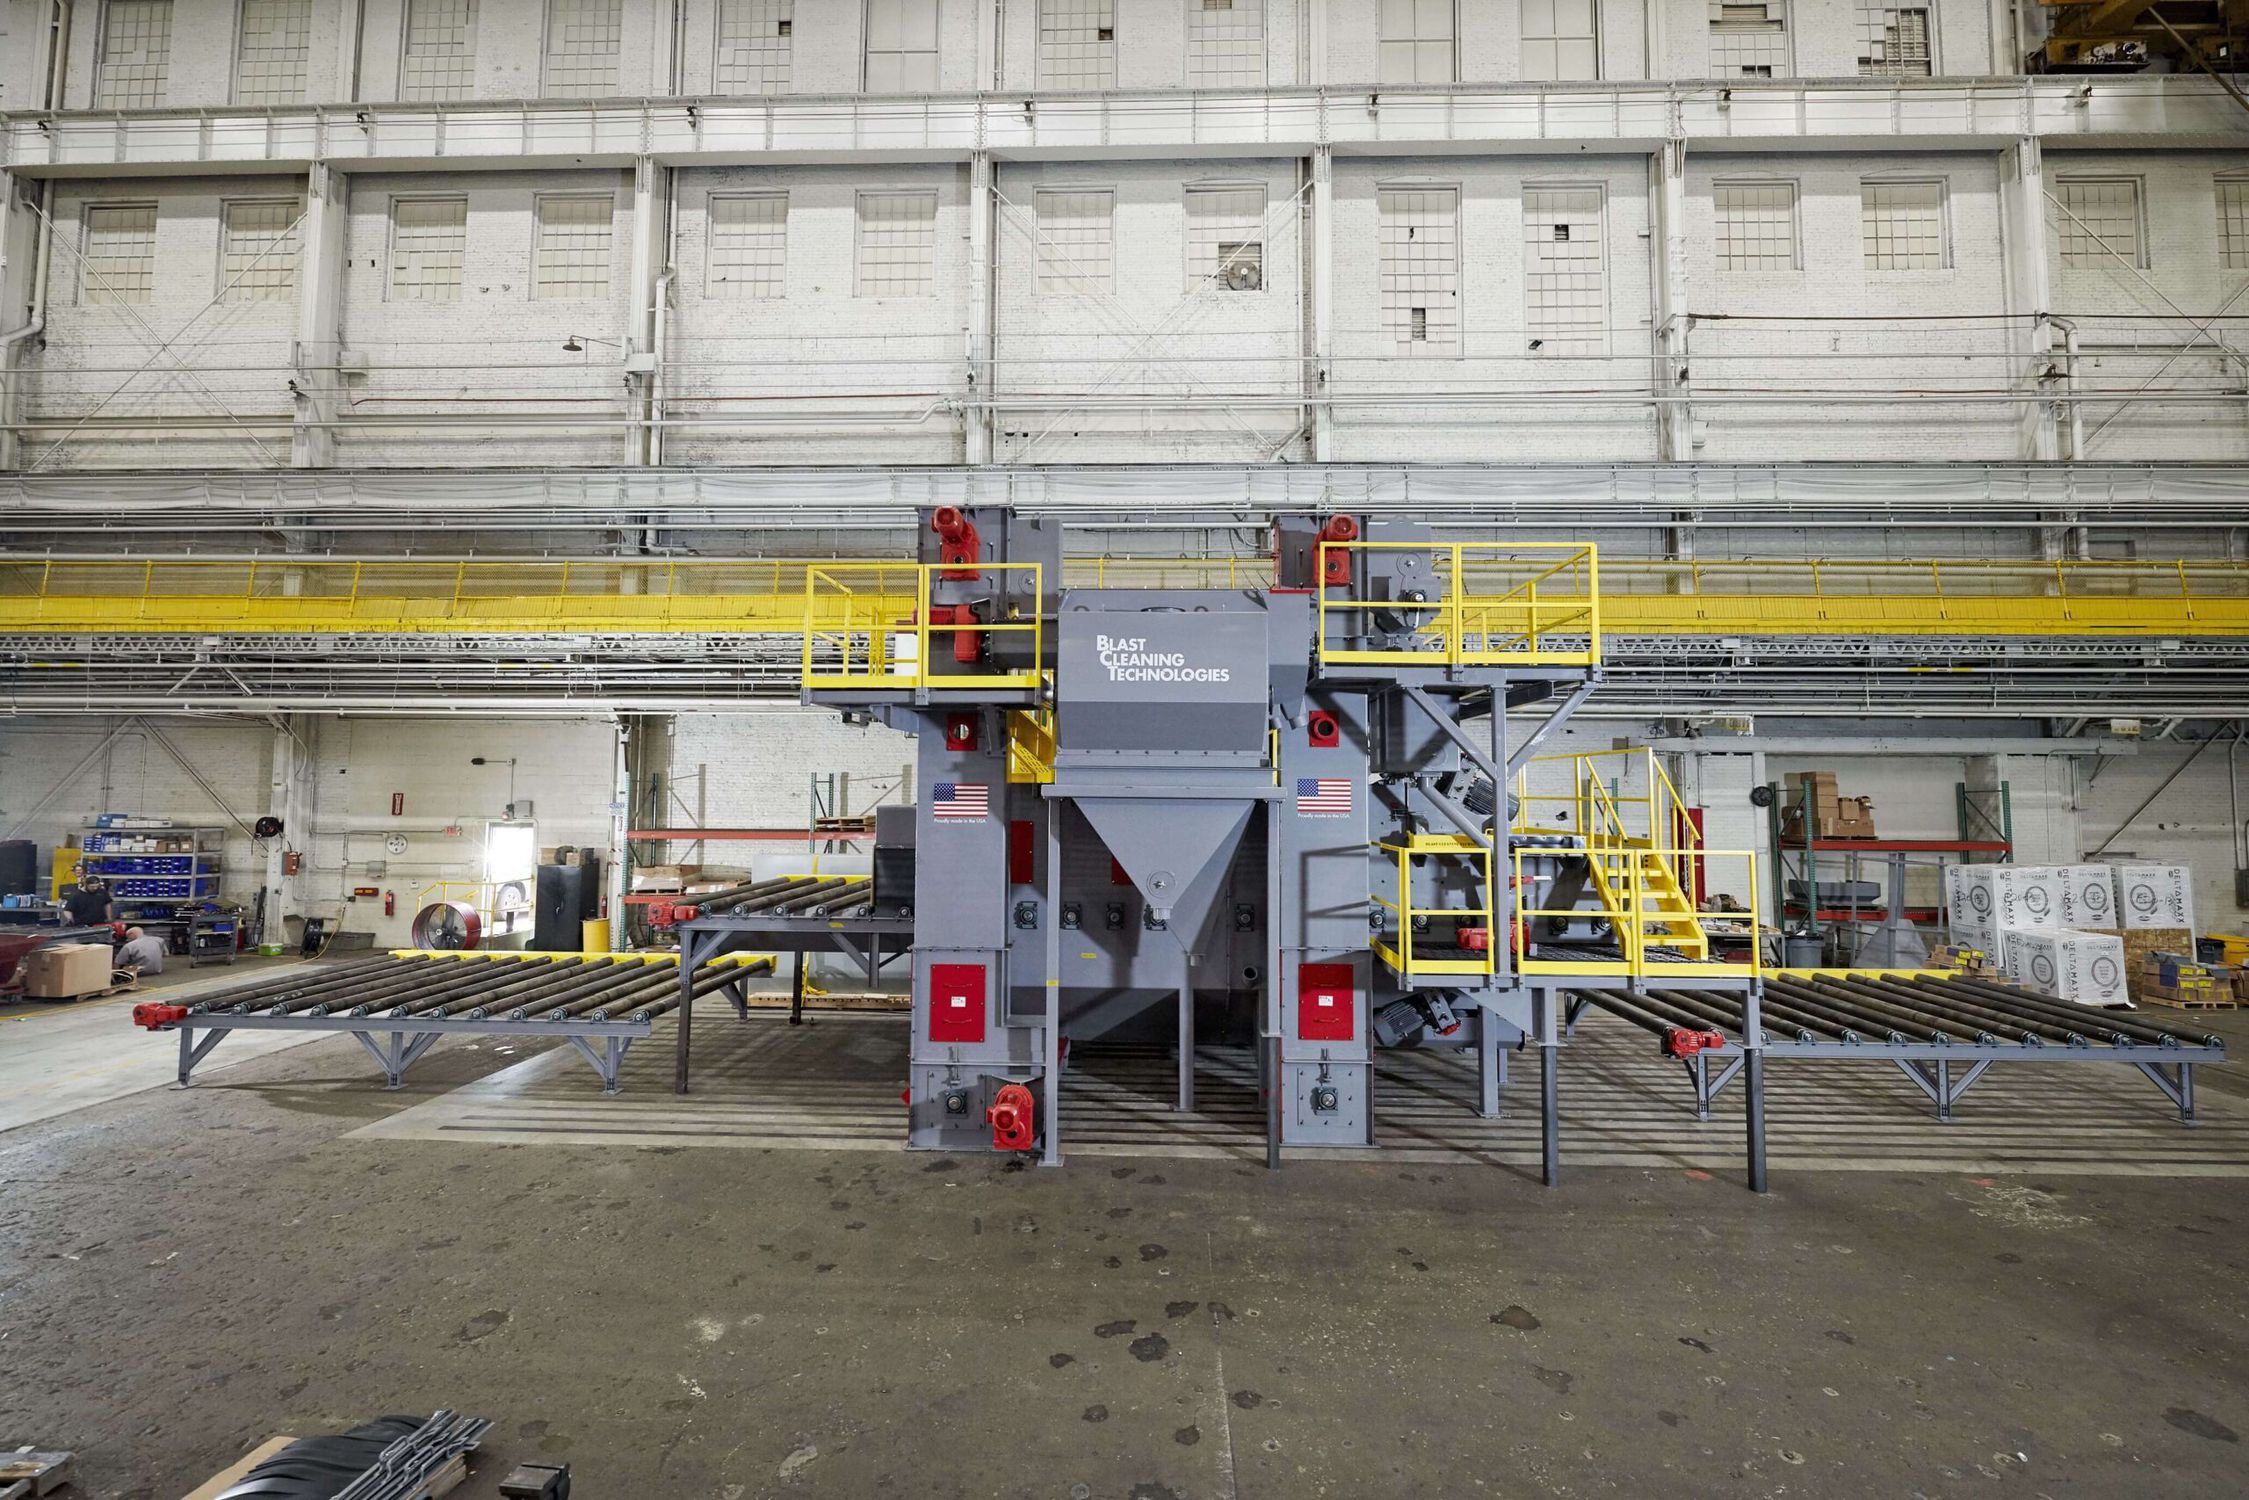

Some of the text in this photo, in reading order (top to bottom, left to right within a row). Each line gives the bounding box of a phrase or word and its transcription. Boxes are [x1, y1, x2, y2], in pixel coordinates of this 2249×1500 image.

[1096, 634, 1147, 652] BLAST
[1099, 650, 1185, 667] CLEANING
[1107, 665, 1230, 682] TECHNOLOGIES
[2063, 868, 2074, 923] DELTAMAXX
[2174, 869, 2184, 923] DELTAMAXX
[1985, 930, 1995, 966] DELTAM
[2010, 934, 2020, 976] DELTAMA
